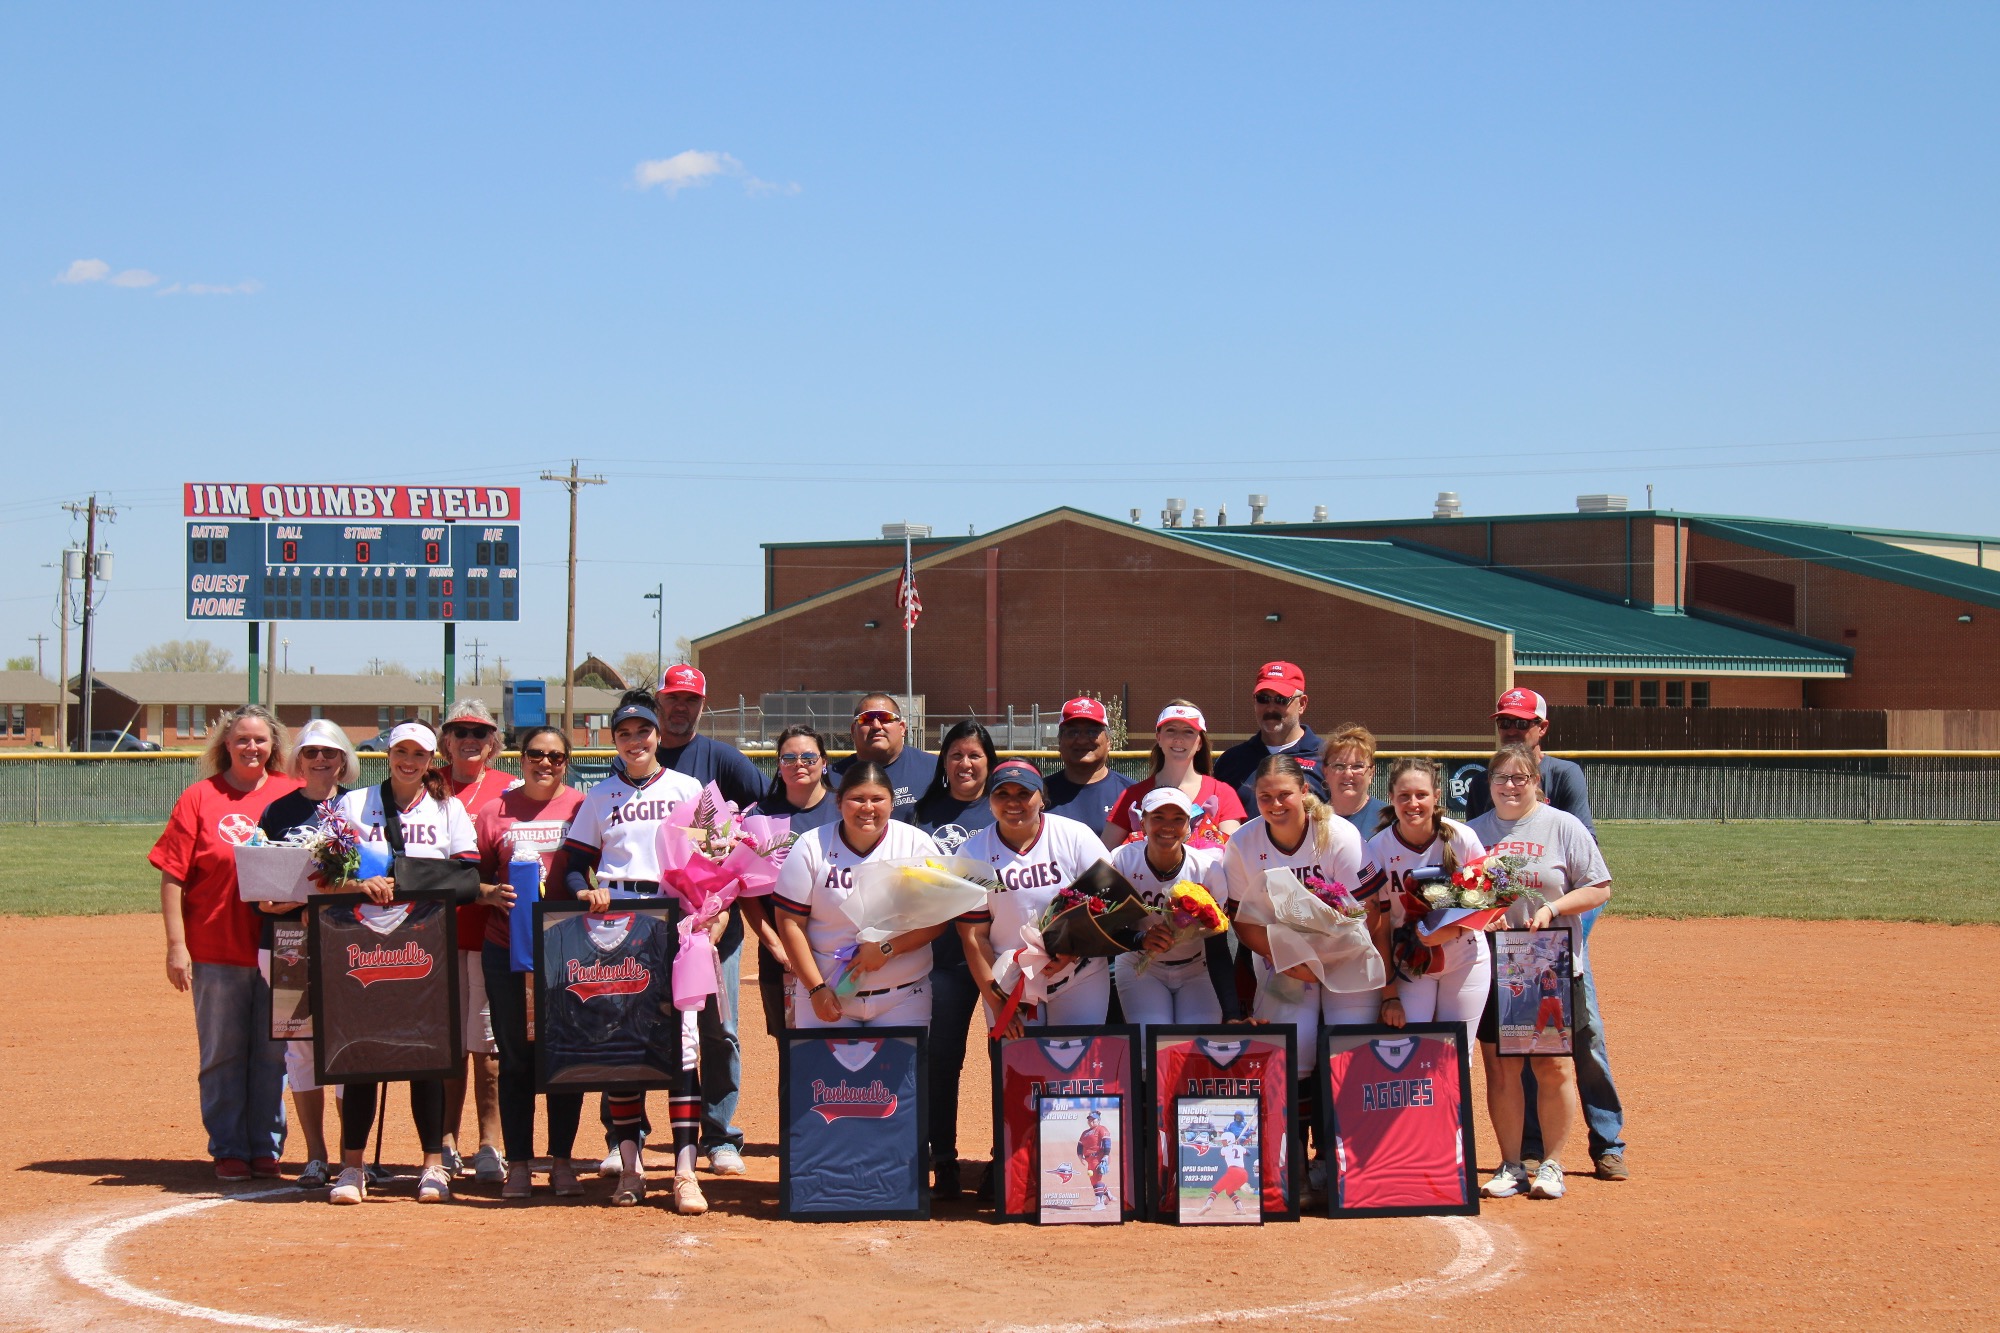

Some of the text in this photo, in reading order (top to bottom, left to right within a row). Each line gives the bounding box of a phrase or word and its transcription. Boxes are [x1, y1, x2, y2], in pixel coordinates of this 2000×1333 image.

[192, 484, 510, 518] JIM QUIMBY FIELD
[191, 525, 229, 538] BATTER
[277, 526, 303, 539] BALL
[344, 527, 382, 539] STRIKE
[421, 528, 445, 540] OUT
[483, 528, 503, 542] H/E
[283, 541, 297, 562] 0
[356, 542, 369, 562] 0
[426, 543, 439, 563] 0
[266, 567, 272, 576] 1
[279, 567, 286, 576] 2
[293, 567, 300, 576] 3
[313, 567, 320, 576] 4
[326, 567, 334, 576] 5
[340, 567, 348, 576] 6
[361, 568, 368, 577] 7
[405, 568, 416, 577] 10
[499, 568, 517, 578] ERR
[191, 575, 249, 593] GUEST
[443, 579, 453, 595] 0
[191, 598, 246, 616] HOME
[443, 601, 453, 617] 0
[369, 823, 437, 846] AGIES
[1484, 841, 1546, 857] PSU
[994, 860, 1062, 893] AGGIES
[277, 938, 303, 946] Torres
[346, 940, 425, 968] Panhandle
[566, 956, 643, 982] Panhandle
[811, 1079, 891, 1103] Panhandle
[1362, 1078, 1434, 1112] AGGIES
[1180, 1114, 1209, 1124] Peralta
[1181, 1106, 1208, 1115] Nicole
